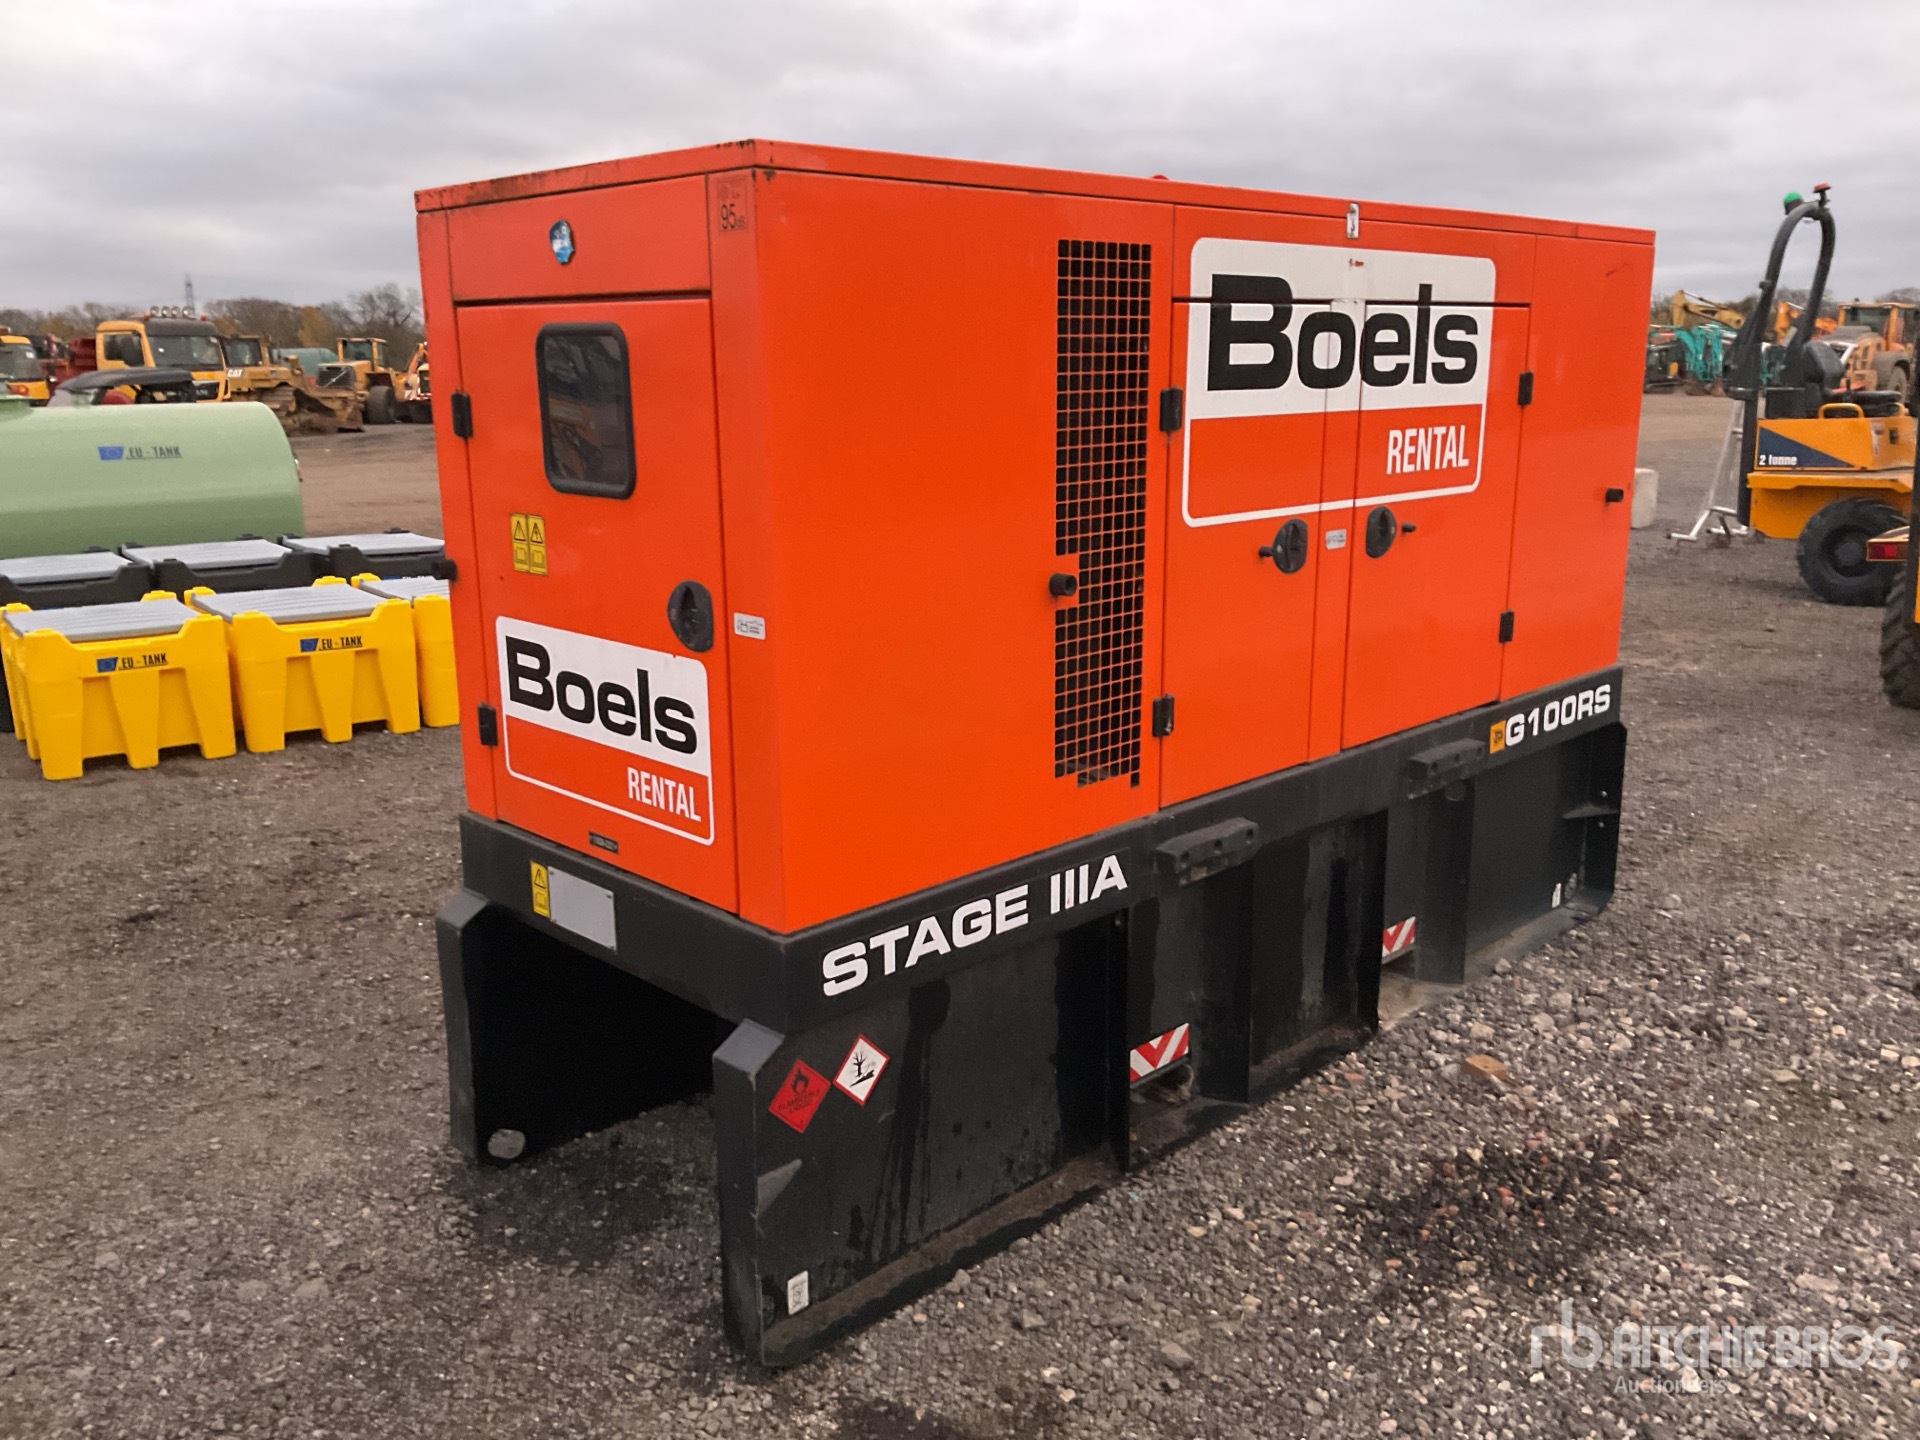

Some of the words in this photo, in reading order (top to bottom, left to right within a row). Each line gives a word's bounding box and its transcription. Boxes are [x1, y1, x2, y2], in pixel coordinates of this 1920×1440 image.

[1207, 273, 1478, 392] Boels
[227, 369, 243, 377] CAT
[1386, 424, 1469, 474] RENTAL
[1759, 455, 1766, 465] 2
[1769, 455, 1797, 465] tonne
[143, 653, 168, 665] TANK
[340, 636, 362, 647] TANK
[505, 636, 697, 754] Boels
[1505, 684, 1611, 747] G100RS
[627, 766, 701, 821] RENTAL
[822, 885, 1029, 997] STAGE
[1050, 855, 1128, 915] IIIA
